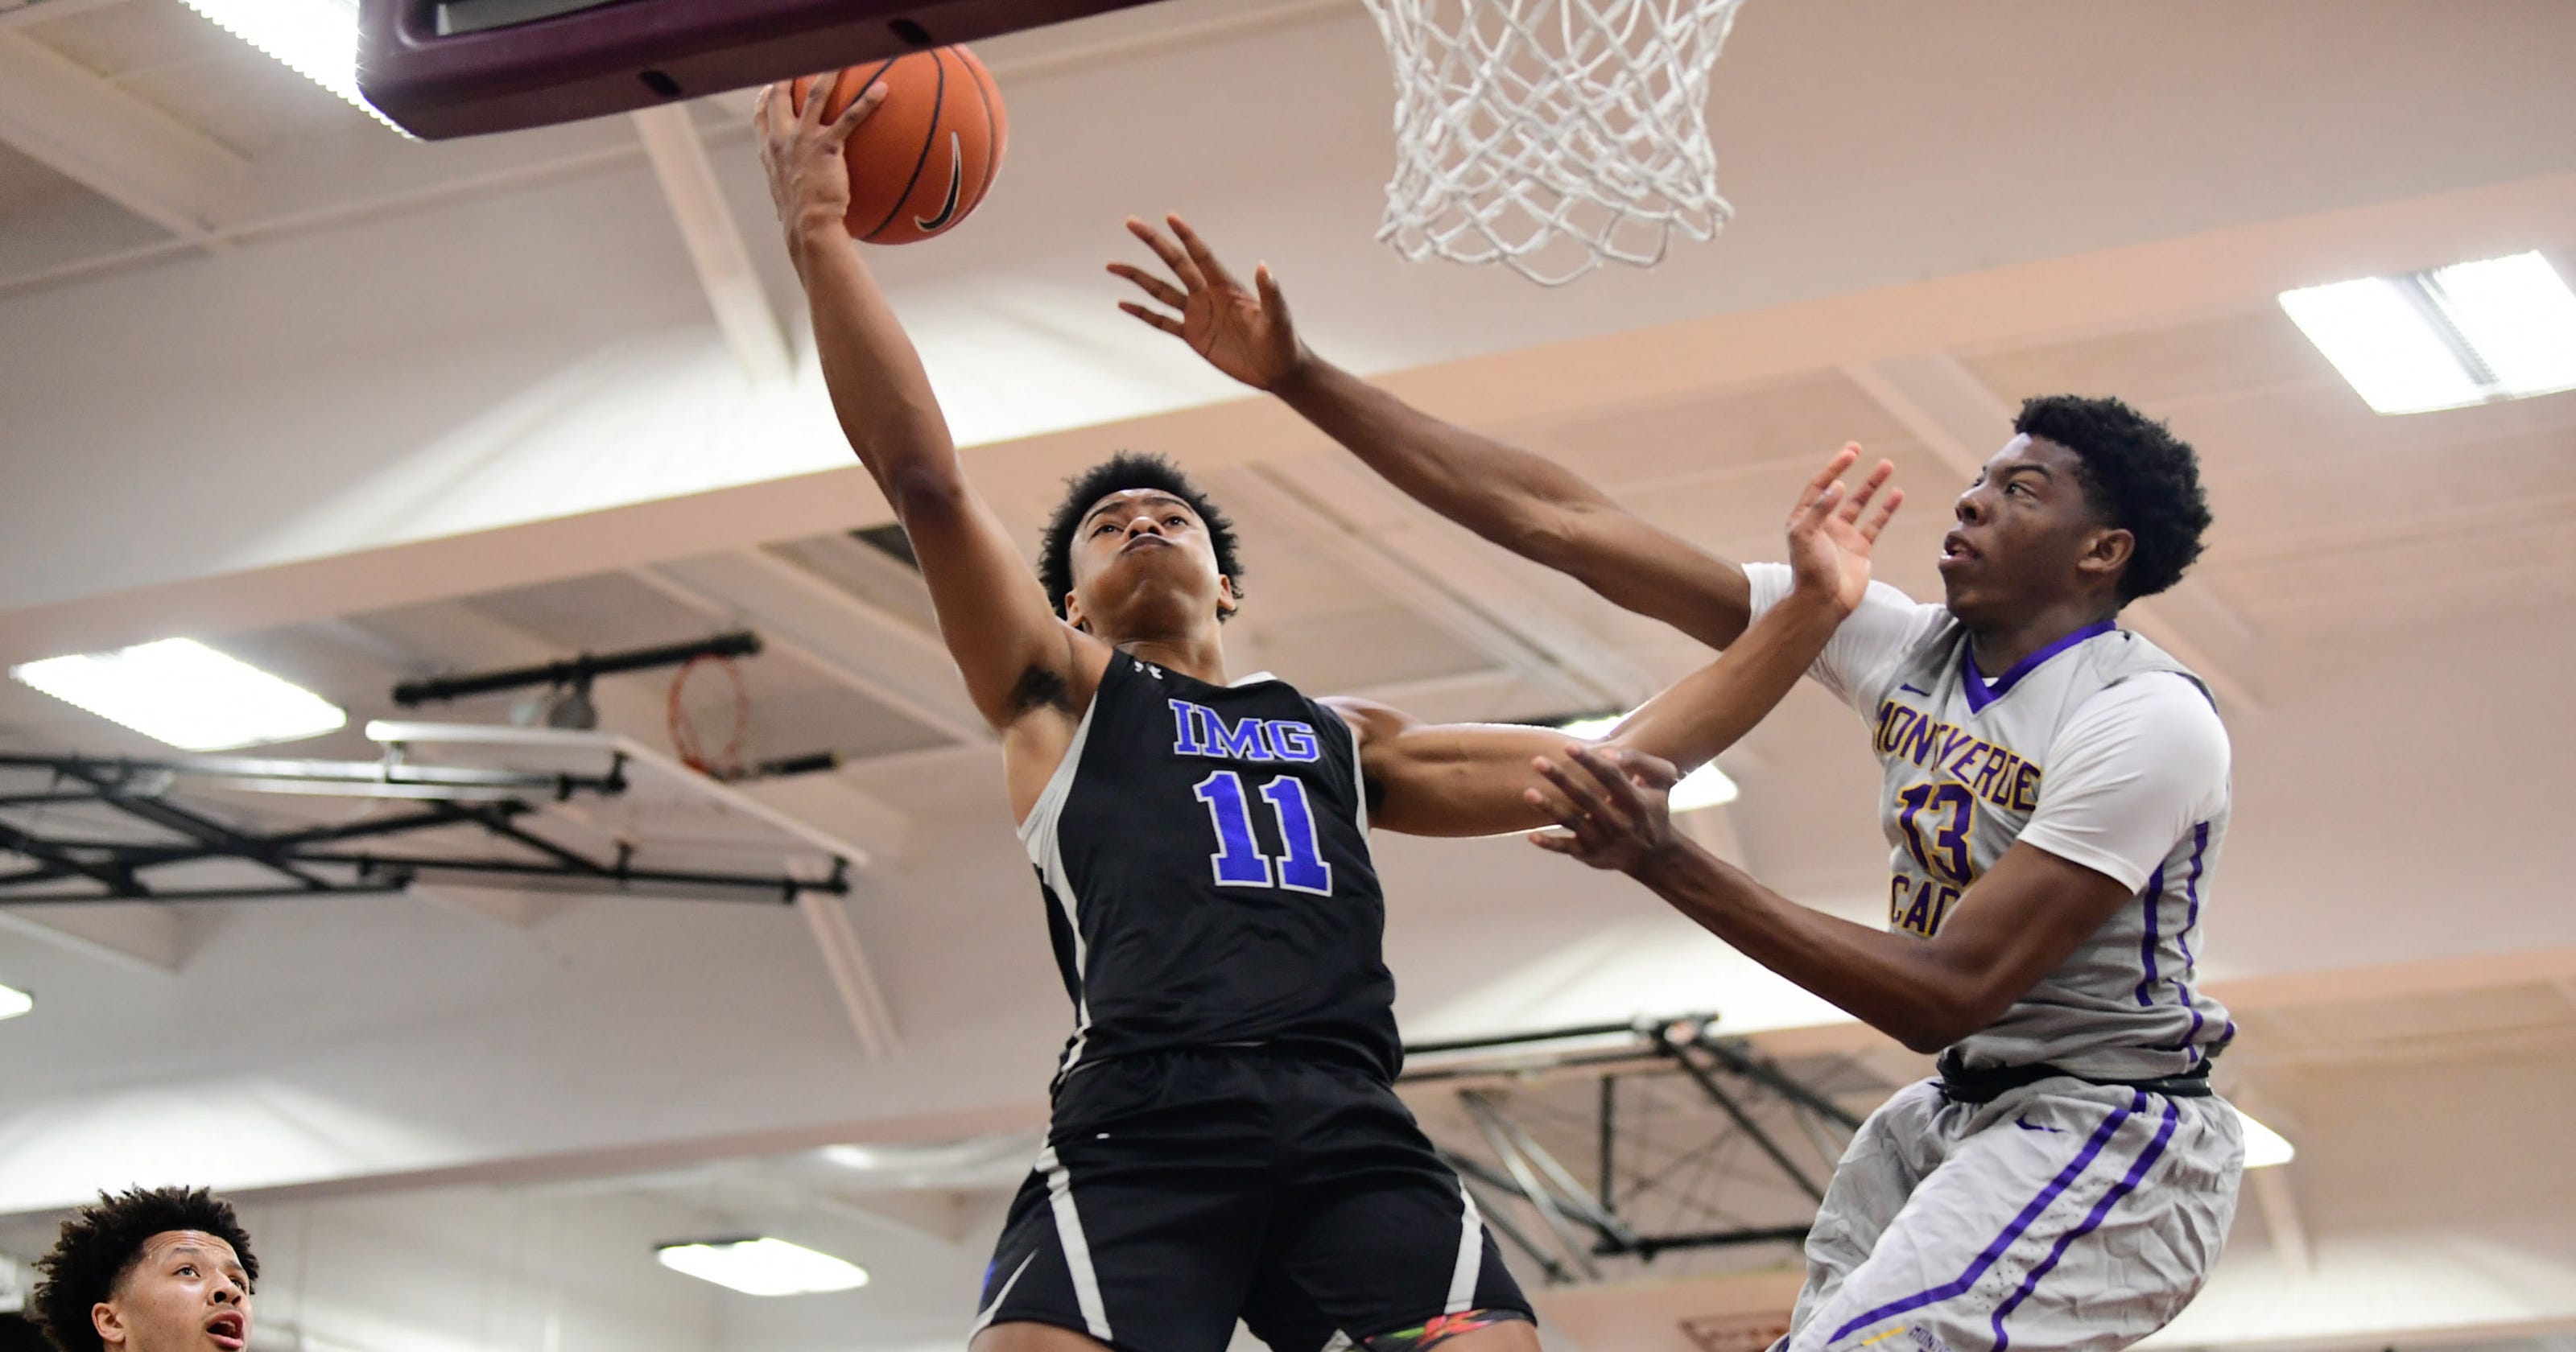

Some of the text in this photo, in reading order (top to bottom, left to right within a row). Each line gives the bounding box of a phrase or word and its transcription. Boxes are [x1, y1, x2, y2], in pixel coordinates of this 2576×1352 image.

[1168, 698, 1321, 763] IMG
[1192, 770, 1332, 897] 11
[1896, 781, 1975, 888] 13
